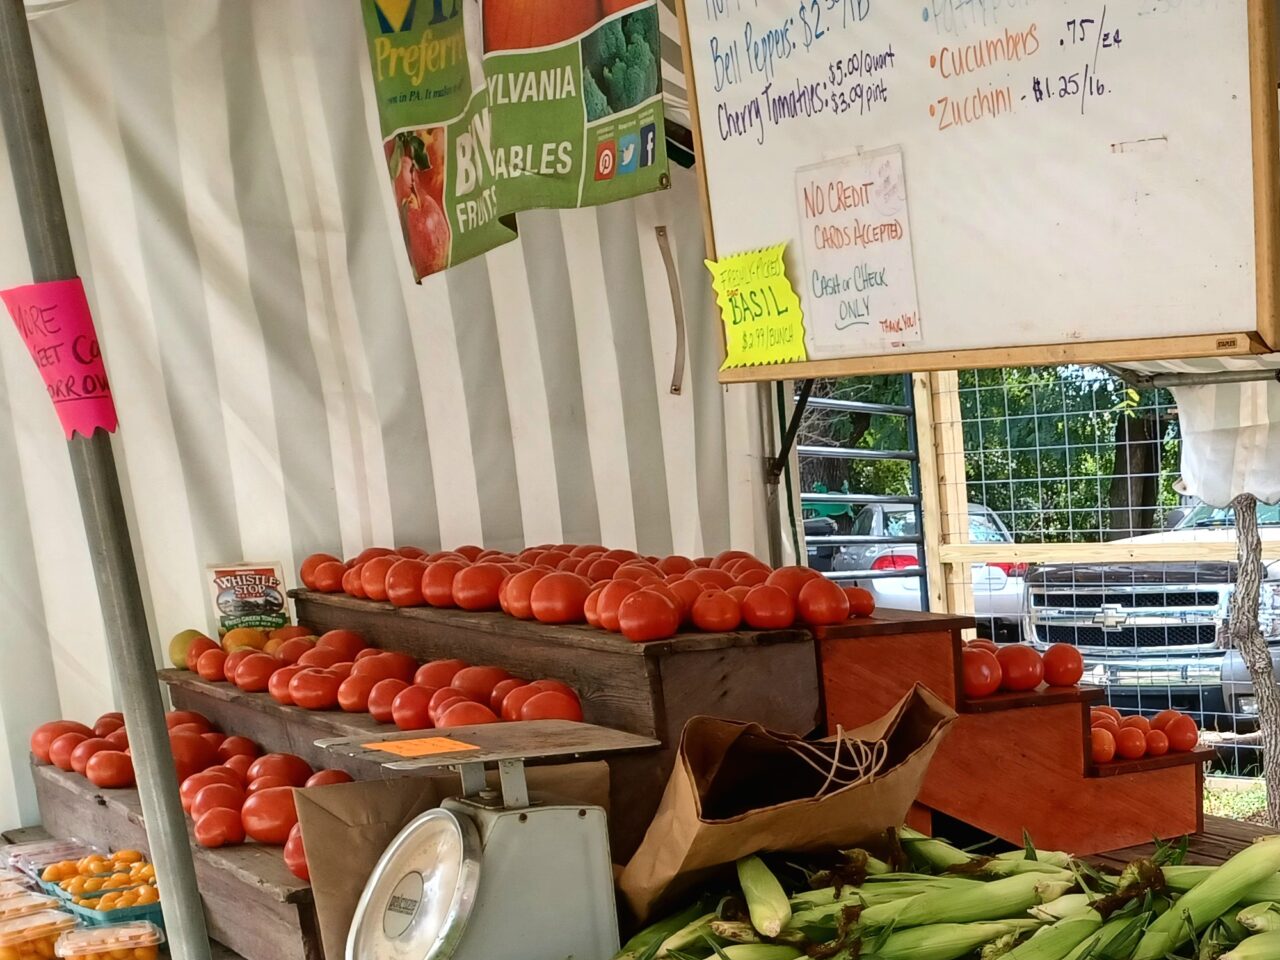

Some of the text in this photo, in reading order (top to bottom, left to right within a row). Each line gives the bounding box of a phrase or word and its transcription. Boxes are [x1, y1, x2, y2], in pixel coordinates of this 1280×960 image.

[710, 36, 742, 92] Bell
[487, 65, 576, 106] YLVANIA
[938, 75, 1013, 131] Zucchini
[717, 95, 765, 145] Cherry
[494, 141, 572, 180] ABLES
[803, 181, 825, 218] NO
[828, 180, 874, 213] CREDIT
[814, 218, 903, 250] CARDS ACCEPTED
[812, 269, 841, 298] CASH
[853, 263, 888, 293] CHECK
[728, 286, 788, 325] BASIL
[839, 295, 871, 322] ONLY
[879, 317, 903, 334] THANK
[216, 575, 277, 588] WHISTLE
[235, 585, 266, 594] STOP
